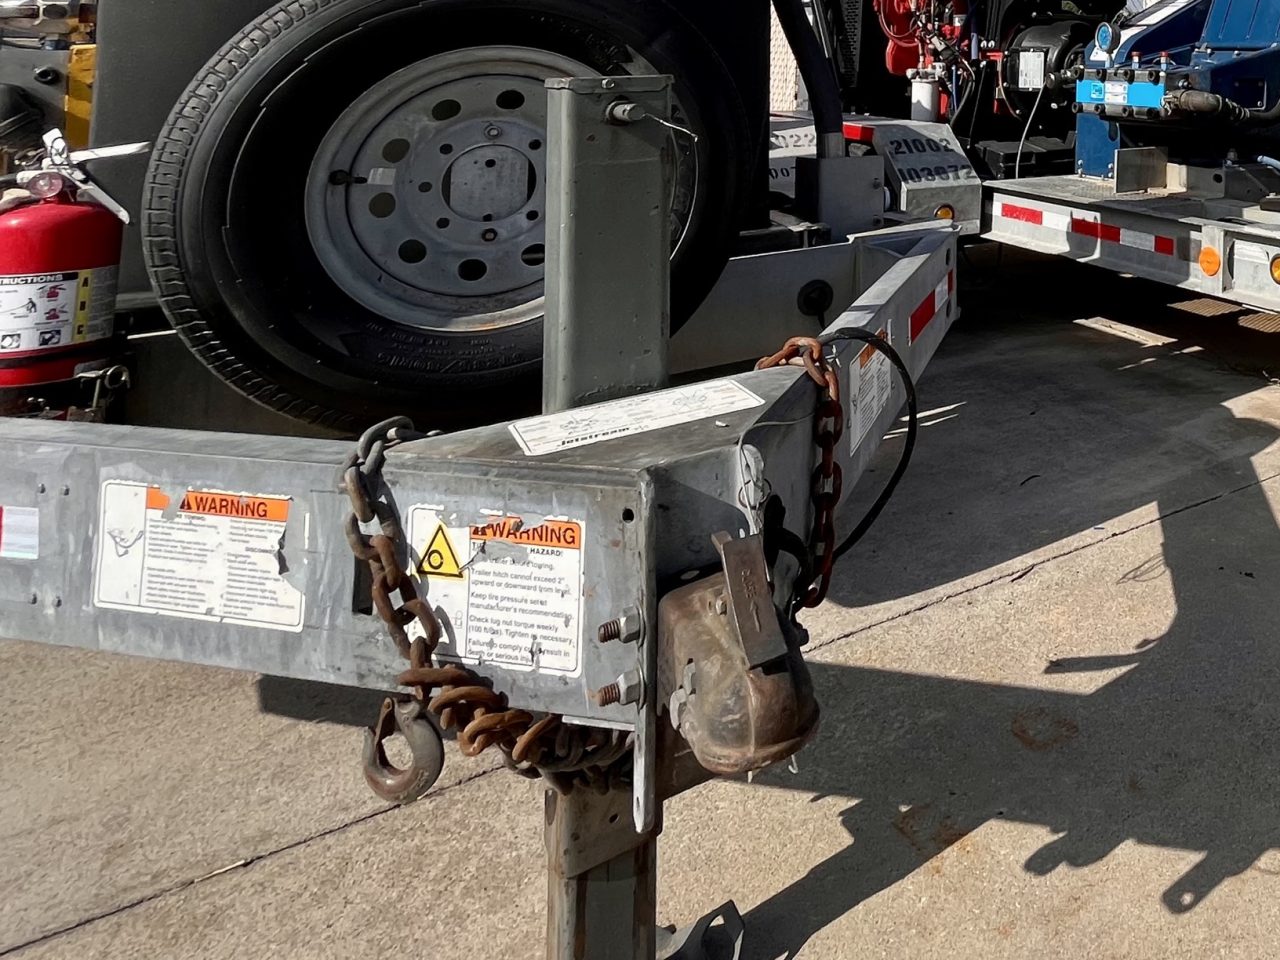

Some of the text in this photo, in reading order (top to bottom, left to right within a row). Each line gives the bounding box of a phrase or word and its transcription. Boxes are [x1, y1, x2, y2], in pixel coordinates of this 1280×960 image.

[890, 137, 955, 155] 21002
[82, 276, 89, 288] A
[195, 495, 268, 518] WARNING
[493, 570, 509, 578] hitch
[533, 575, 557, 584] exceed
[470, 592, 487, 600] Keep
[500, 595, 528, 604] pressure
[468, 614, 488, 623] Check
[490, 616, 500, 627] lug
[536, 622, 559, 633] weekly
